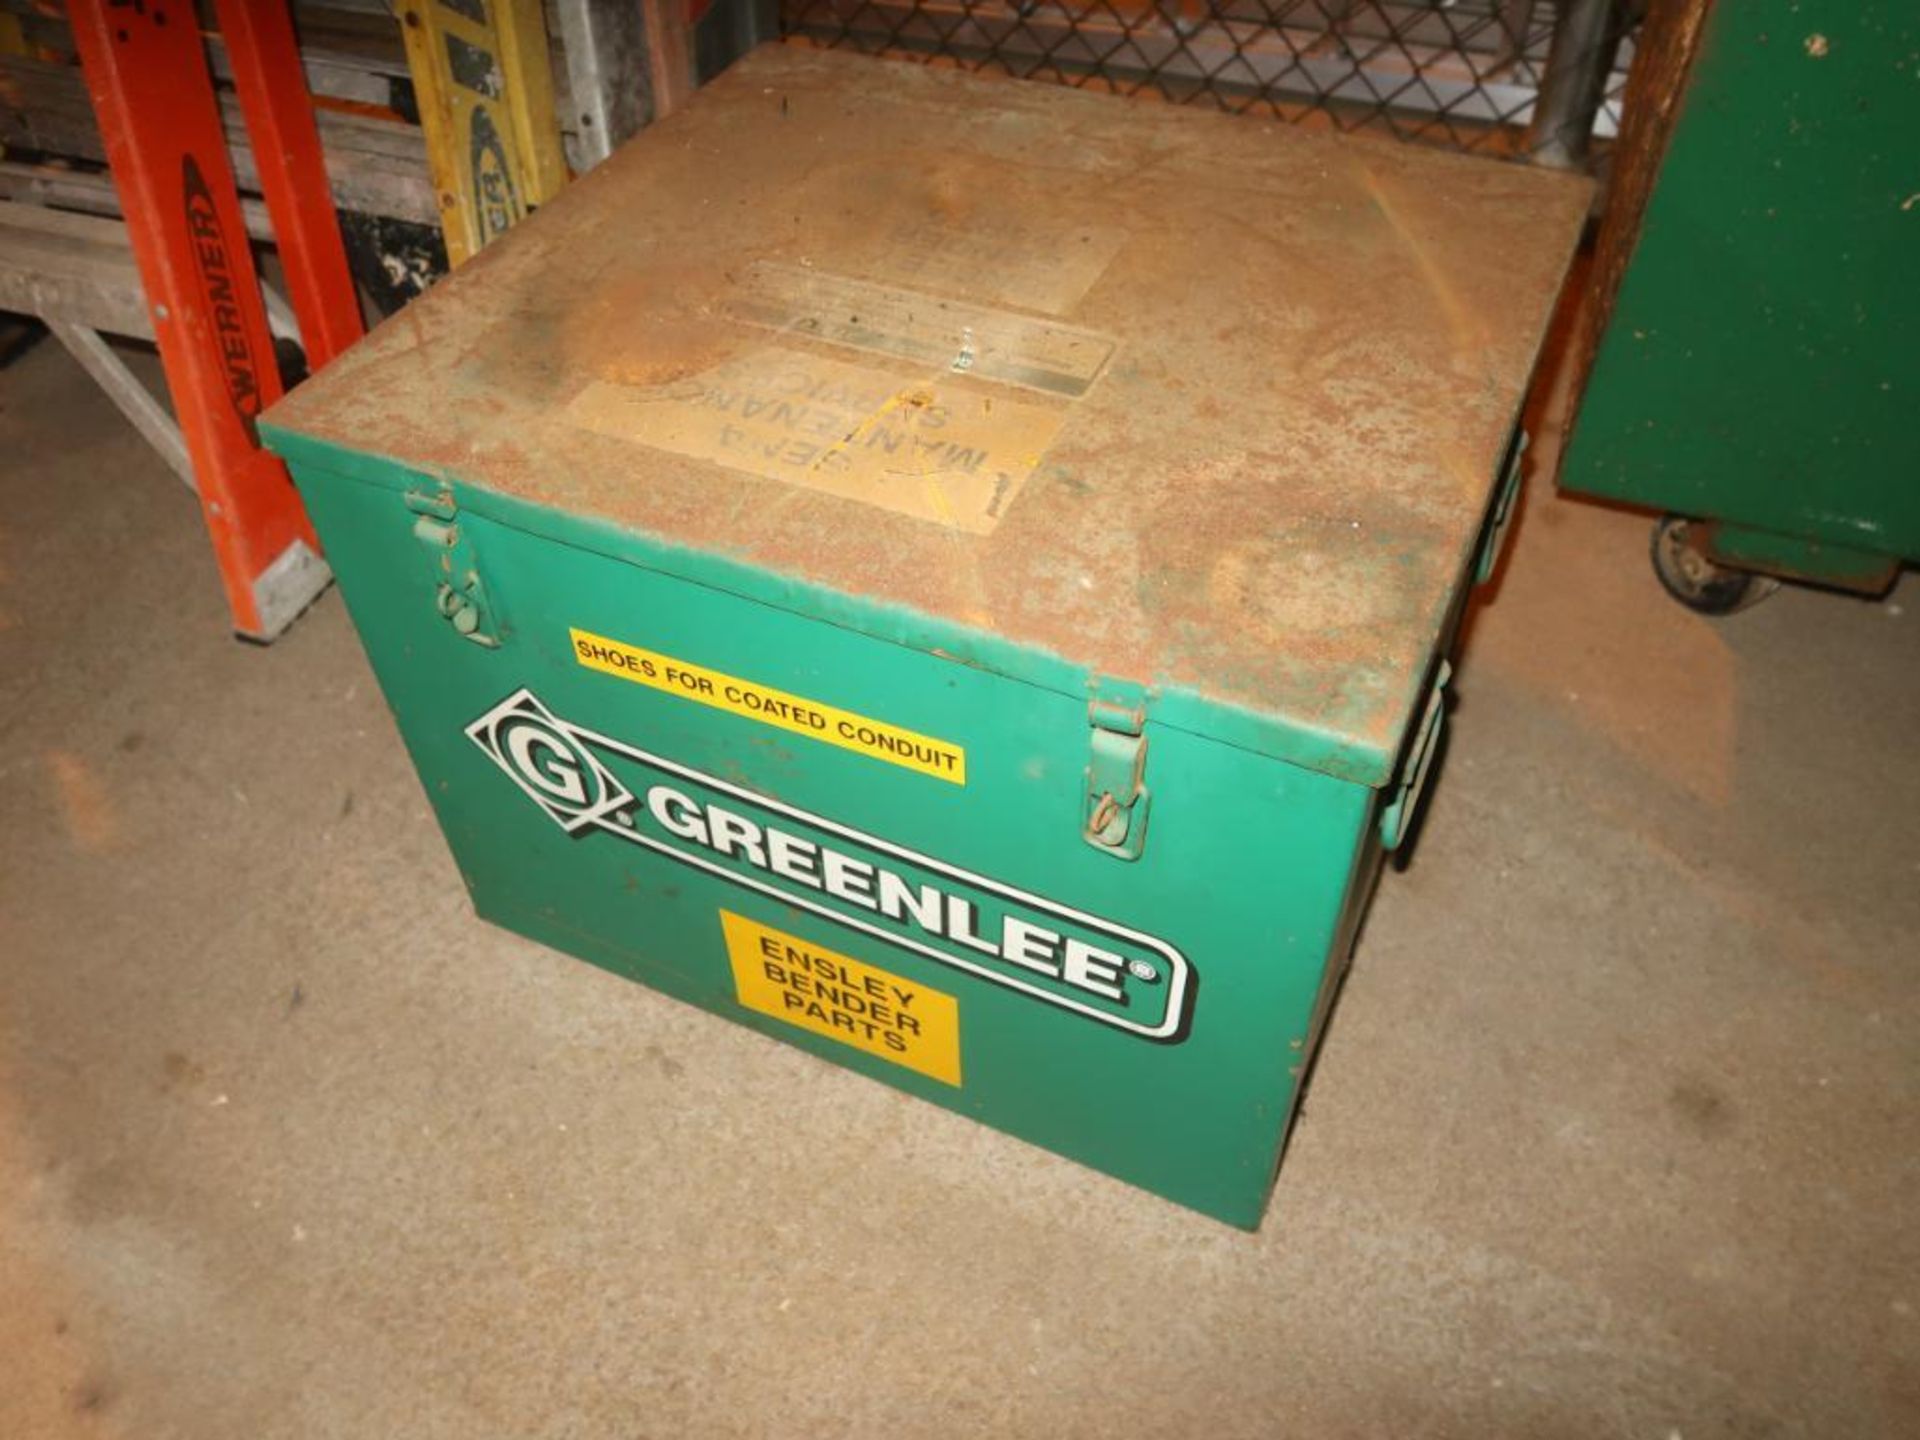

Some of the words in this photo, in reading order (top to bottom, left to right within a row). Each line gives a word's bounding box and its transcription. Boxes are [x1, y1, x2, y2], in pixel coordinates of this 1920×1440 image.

[189, 208, 255, 398] WERNER
[576, 639, 657, 678] SHOES
[665, 666, 714, 697] FOR
[725, 686, 827, 731] COATED
[837, 721, 958, 772] CONDUIT
[507, 725, 588, 805] G
[647, 785, 1125, 1001] GREENLEE
[759, 936, 915, 1008] ENSLEY
[763, 961, 921, 1037] BENDER
[783, 990, 907, 1053] PARTS
